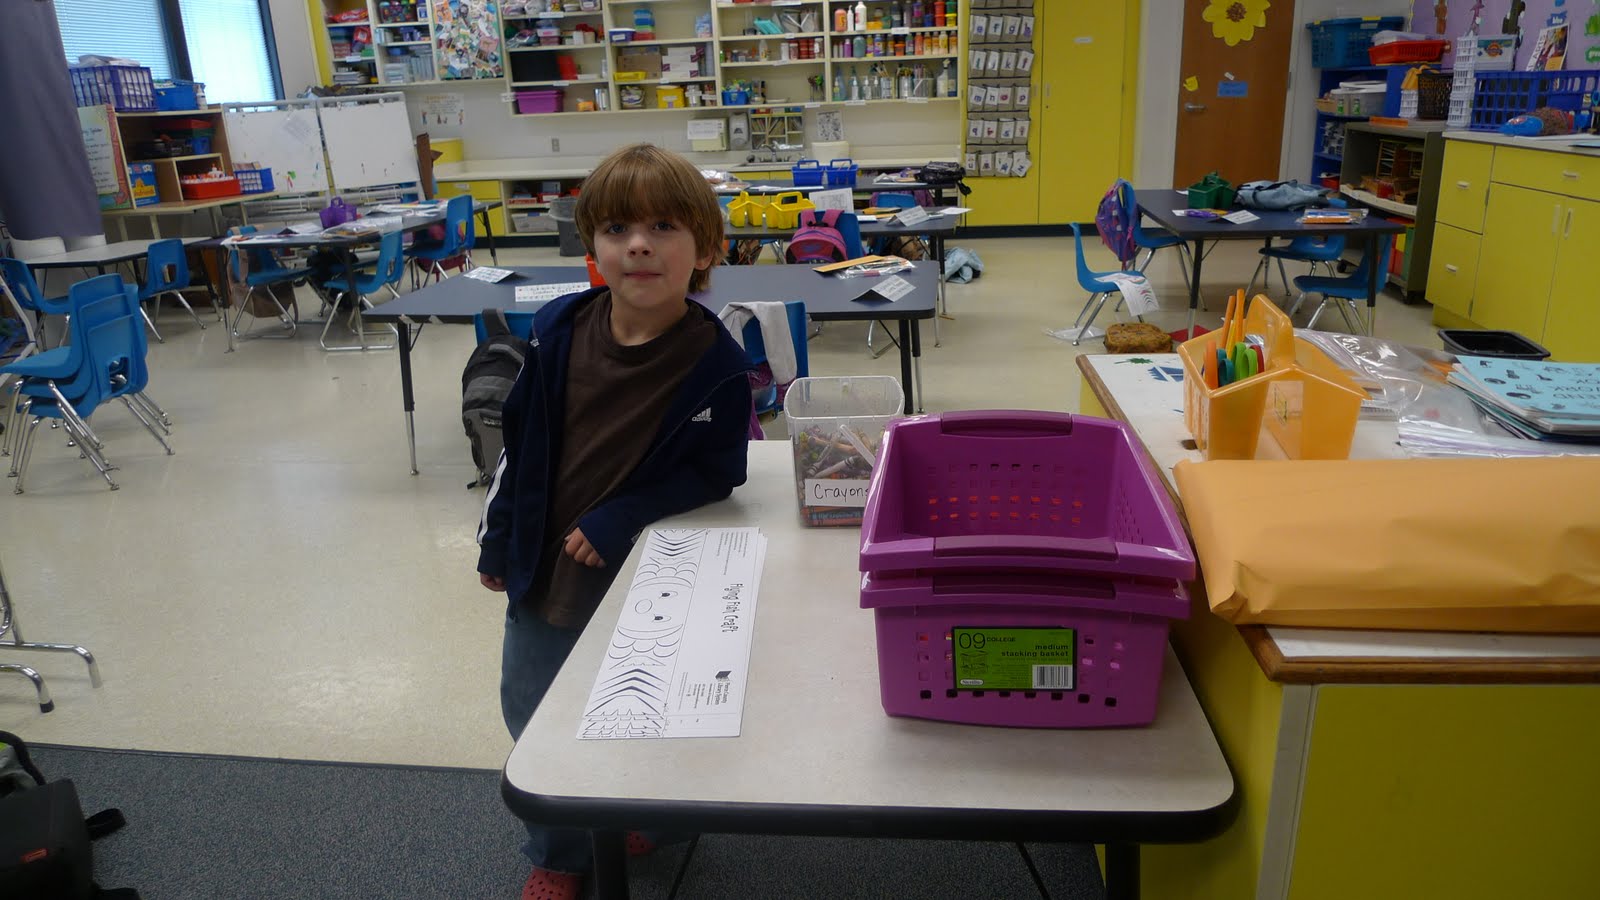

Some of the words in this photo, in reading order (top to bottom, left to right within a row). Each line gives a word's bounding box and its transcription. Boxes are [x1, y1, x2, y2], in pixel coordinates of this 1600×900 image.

[722, 583, 744, 600] Flying
[722, 601, 741, 613] Fish
[720, 615, 739, 633] Craft
[959, 632, 986, 649] 09
